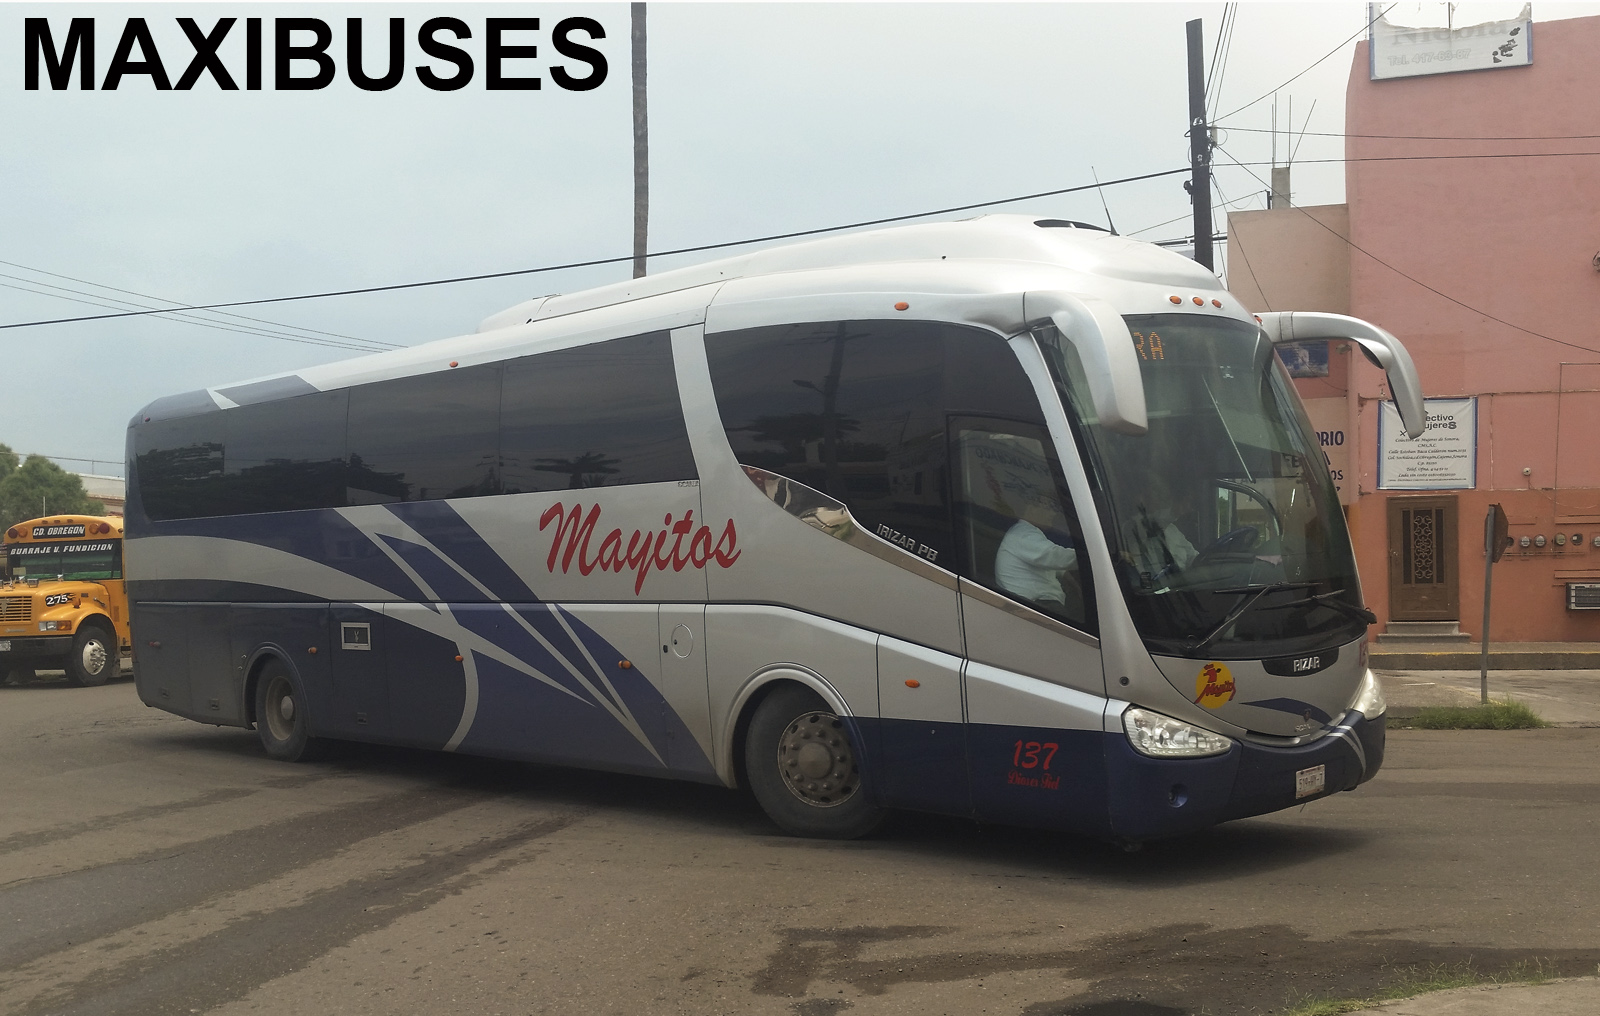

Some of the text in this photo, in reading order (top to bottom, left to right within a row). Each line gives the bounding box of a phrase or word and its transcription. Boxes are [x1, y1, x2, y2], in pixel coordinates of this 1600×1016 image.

[1425, 414, 1454, 422] ectivo
[47, 526, 86, 536] OBREGON
[62, 543, 114, 554] FUNDICION
[876, 523, 939, 562] IRIZAR PB
[539, 502, 741, 597] Mayitos
[45, 594, 69, 606] 275
[1013, 739, 1059, 771] 137
